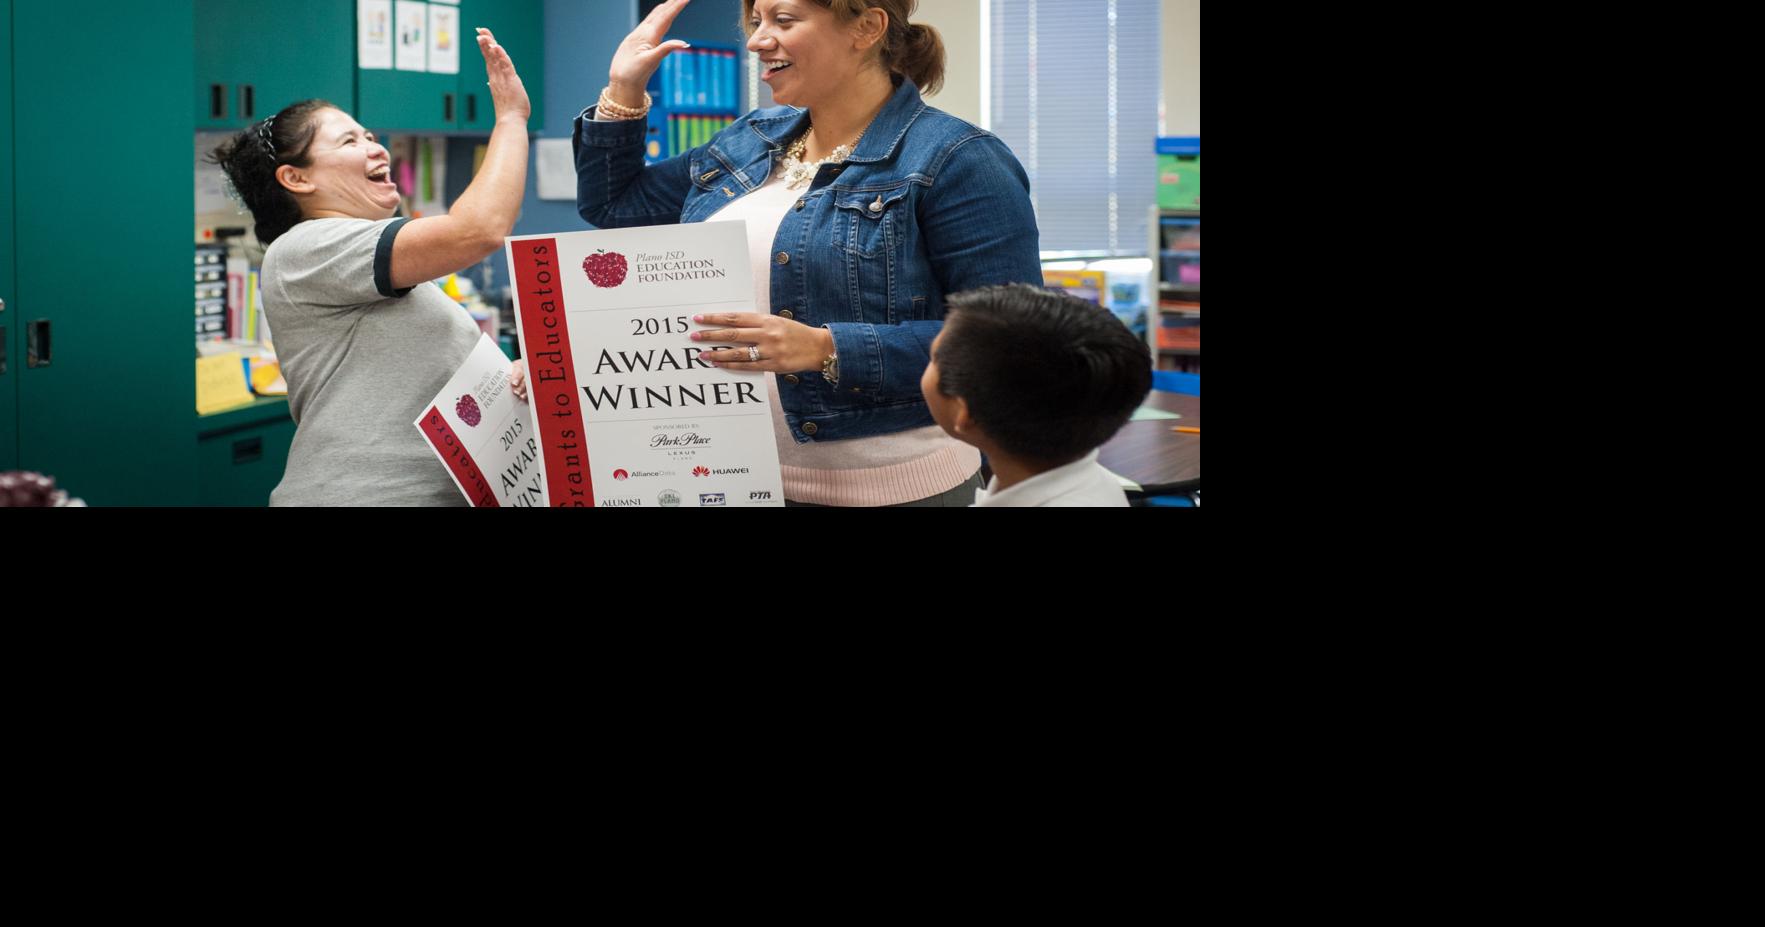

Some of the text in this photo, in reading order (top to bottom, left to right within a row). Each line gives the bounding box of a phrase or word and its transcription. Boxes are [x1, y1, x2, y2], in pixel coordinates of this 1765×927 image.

[636, 251, 685, 262] Plano ISD
[637, 259, 714, 272] EDUCATION
[638, 269, 725, 283] FOUNDATION
[631, 316, 689, 336] 2015
[592, 346, 734, 374] AWAR
[531, 245, 585, 507] rants to Educators
[580, 382, 764, 411] WINNER
[500, 418, 523, 451] 2015
[501, 438, 537, 496] AWAR
[712, 467, 749, 475] HUAWEI
[602, 498, 641, 507] ALUMNI
[749, 491, 771, 500] PTA
